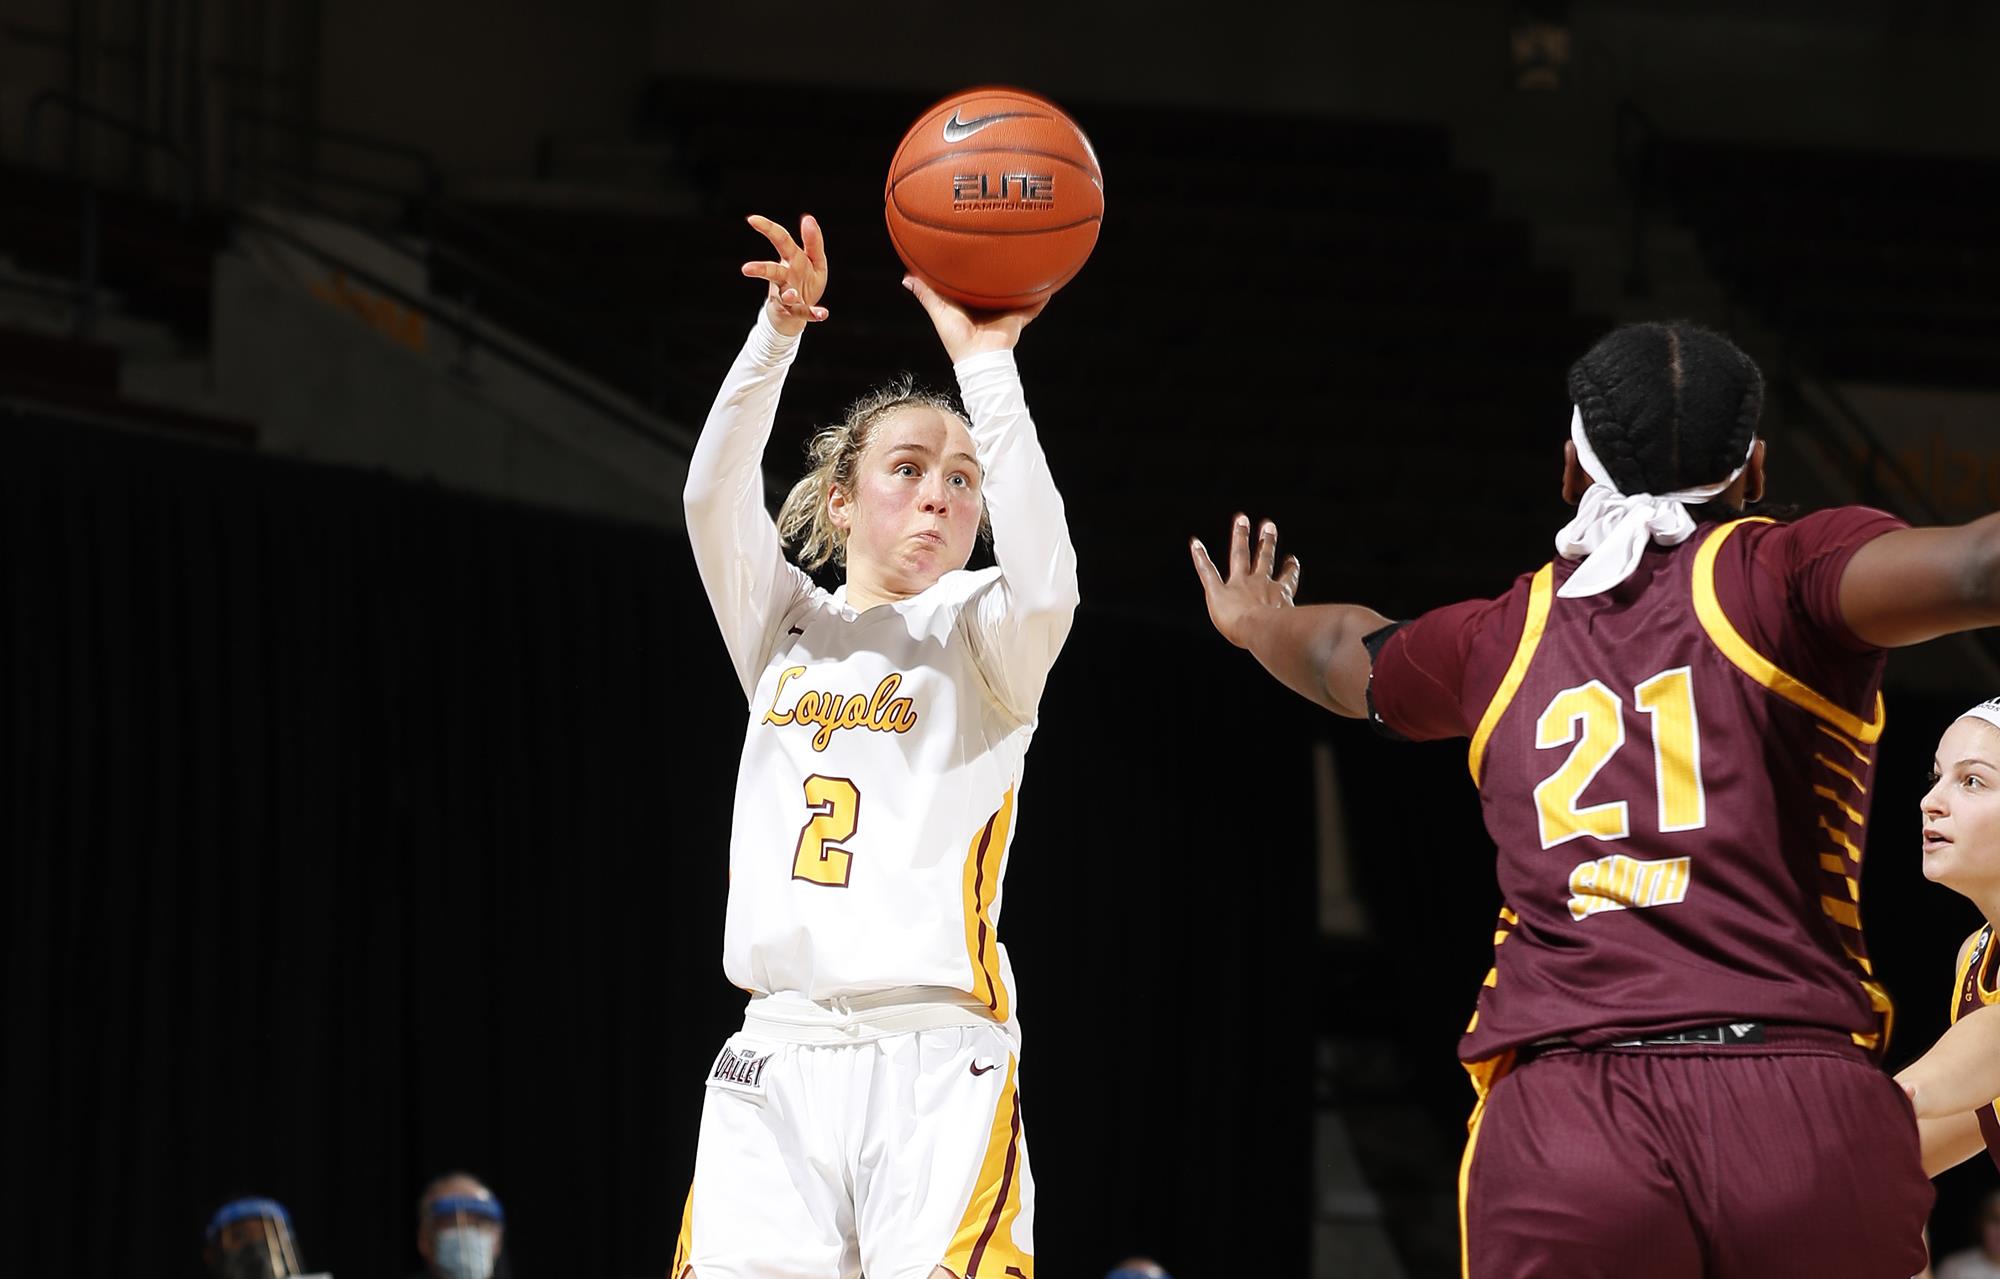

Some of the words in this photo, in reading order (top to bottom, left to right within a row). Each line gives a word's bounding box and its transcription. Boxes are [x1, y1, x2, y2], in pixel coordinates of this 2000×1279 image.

[953, 173, 1054, 201] ELITE
[953, 201, 1054, 212] CHAMPIONSHIP
[761, 665, 918, 752] Loyola
[1533, 664, 1706, 850] 21
[791, 773, 861, 888] 2
[1567, 854, 1692, 921] SMITH
[712, 1046, 775, 1088] VALLEY
